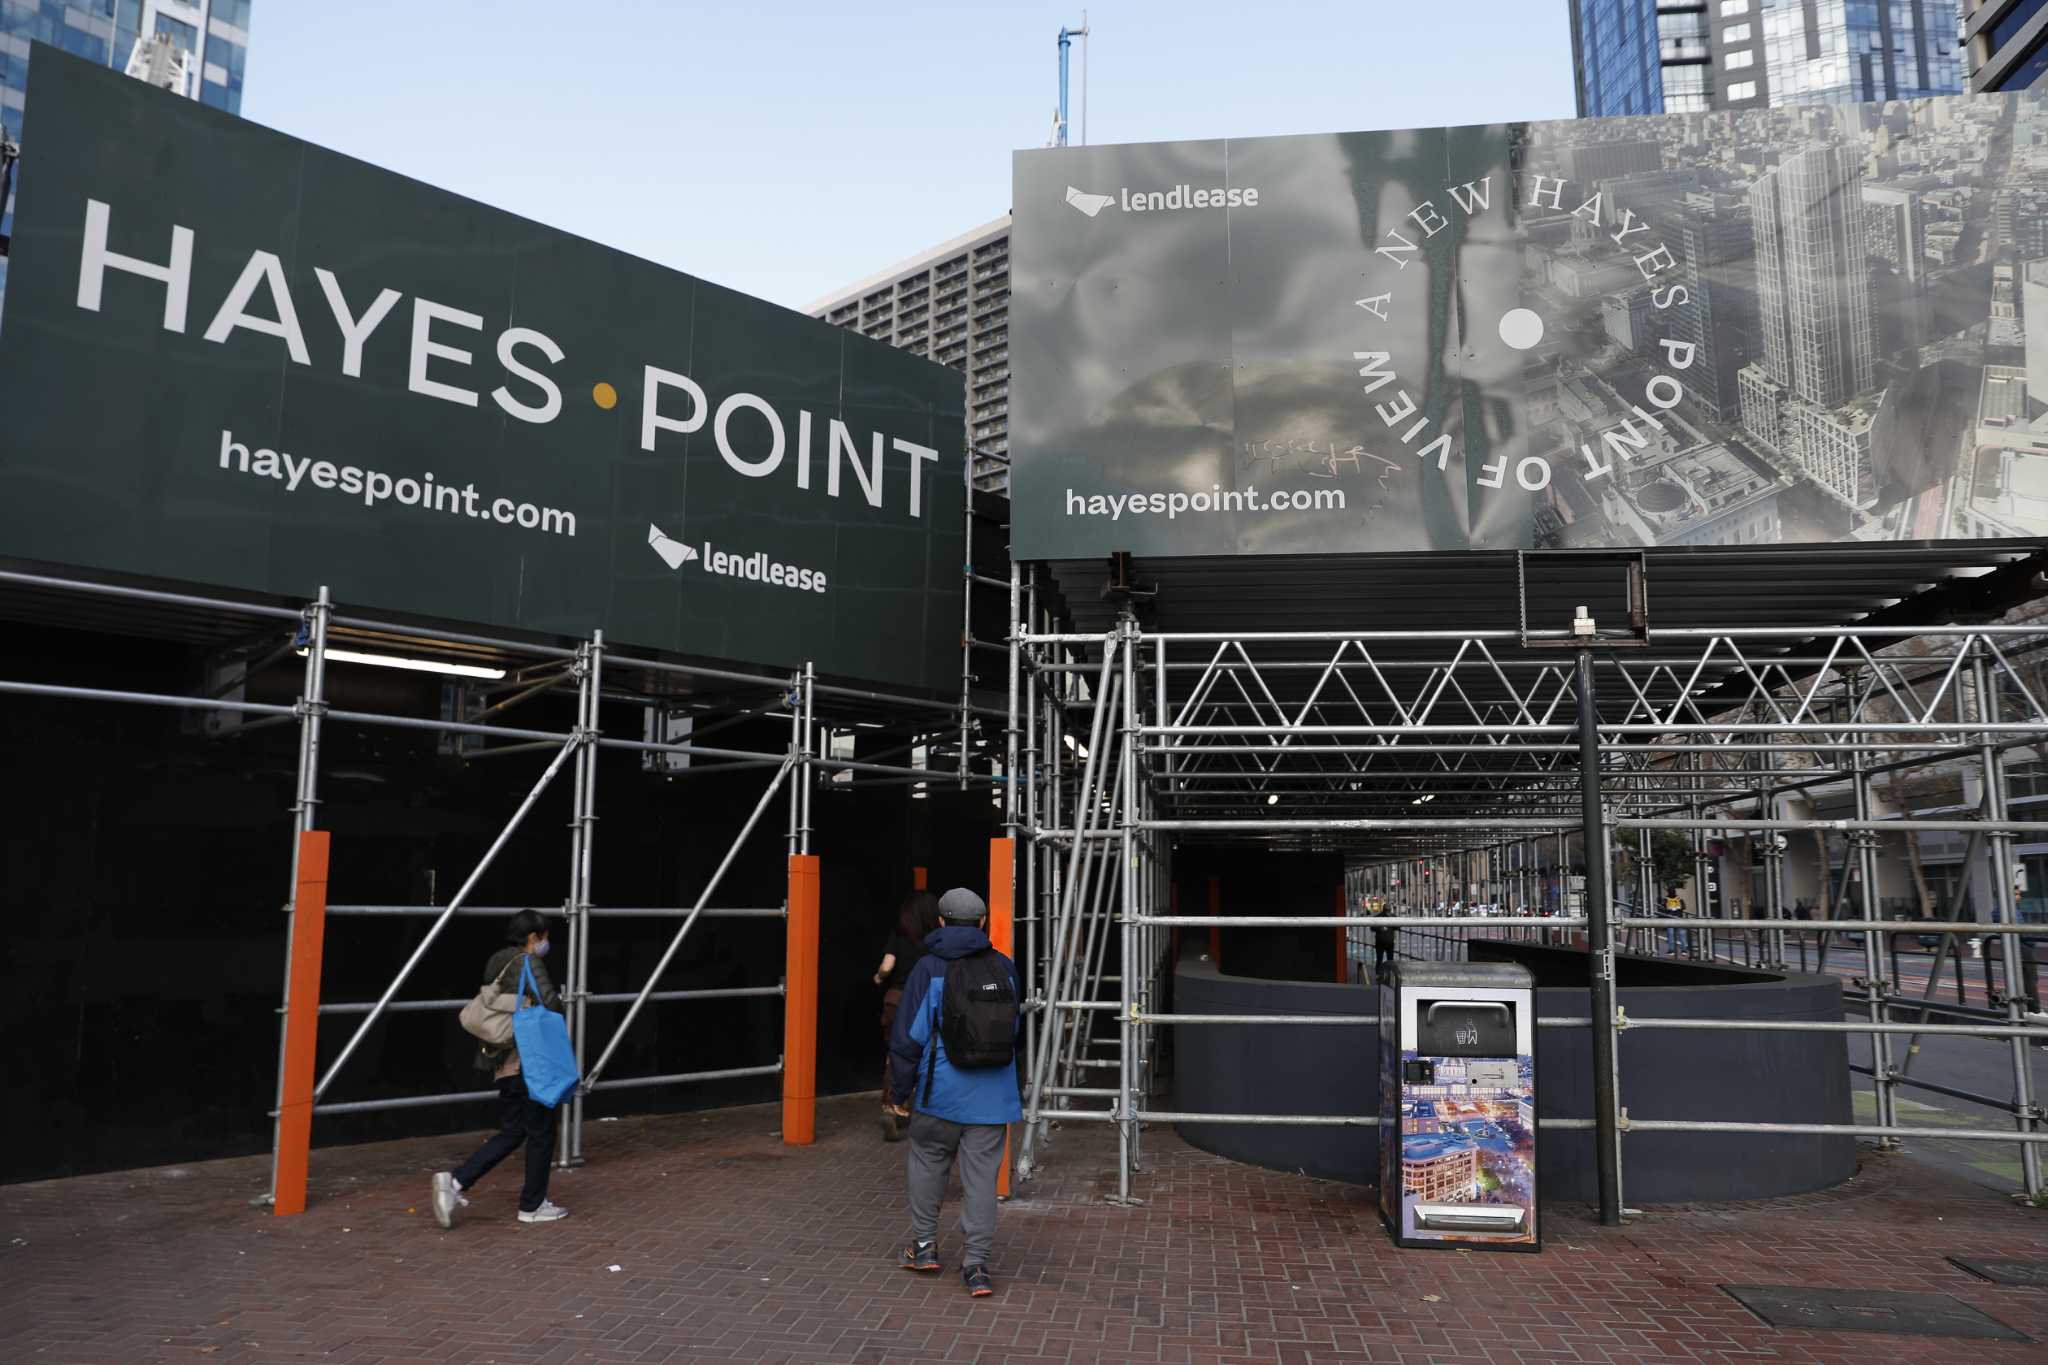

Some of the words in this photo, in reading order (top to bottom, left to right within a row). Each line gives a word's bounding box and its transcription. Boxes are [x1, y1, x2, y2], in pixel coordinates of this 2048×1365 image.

[1121, 185, 1259, 212] lendlease
[1375, 176, 1492, 270] NEW
[1528, 175, 1690, 310] HAYES
[1355, 293, 1392, 322] A
[76, 198, 565, 424] HAYES
[640, 364, 939, 518] POINT
[1353, 351, 1453, 472] VIEW
[1582, 338, 1697, 481] POINT
[219, 430, 577, 536] hayespoint.com
[1066, 485, 1346, 521] hayespoint.com
[1476, 455, 1552, 491] OF
[703, 541, 827, 594] lendlease
